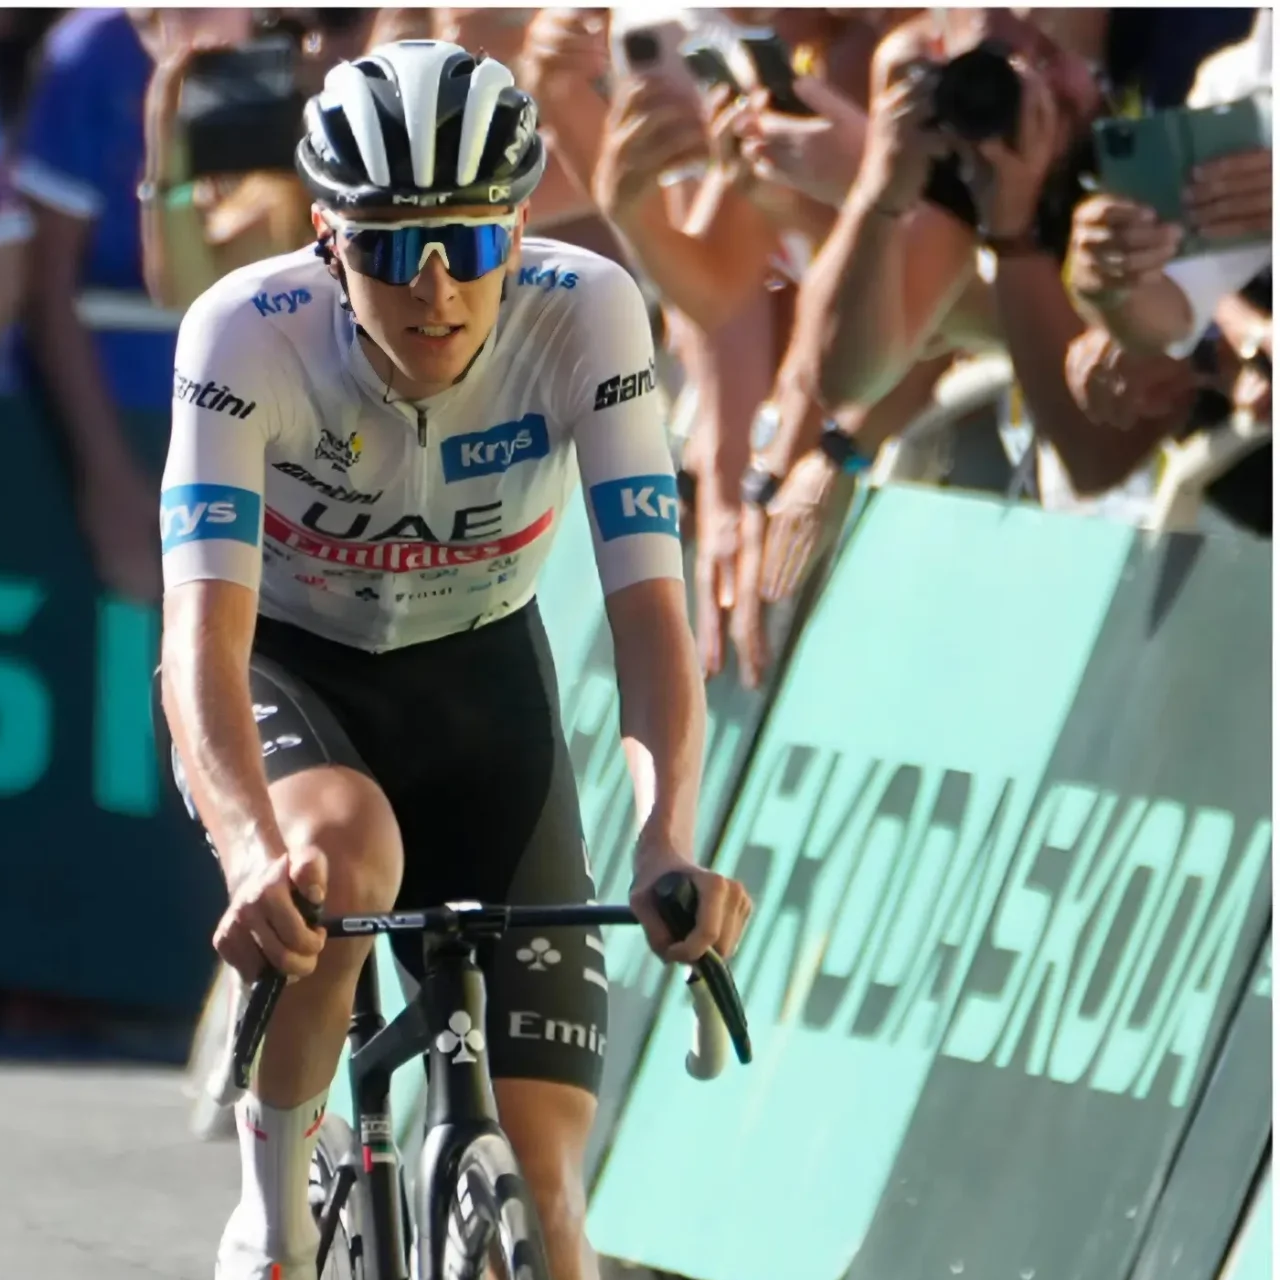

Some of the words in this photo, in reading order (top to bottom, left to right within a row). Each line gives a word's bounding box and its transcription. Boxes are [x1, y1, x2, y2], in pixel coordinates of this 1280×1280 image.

[250, 287, 313, 317] Krys
[460, 429, 533, 467] Krys
[301, 500, 502, 542] UAE
